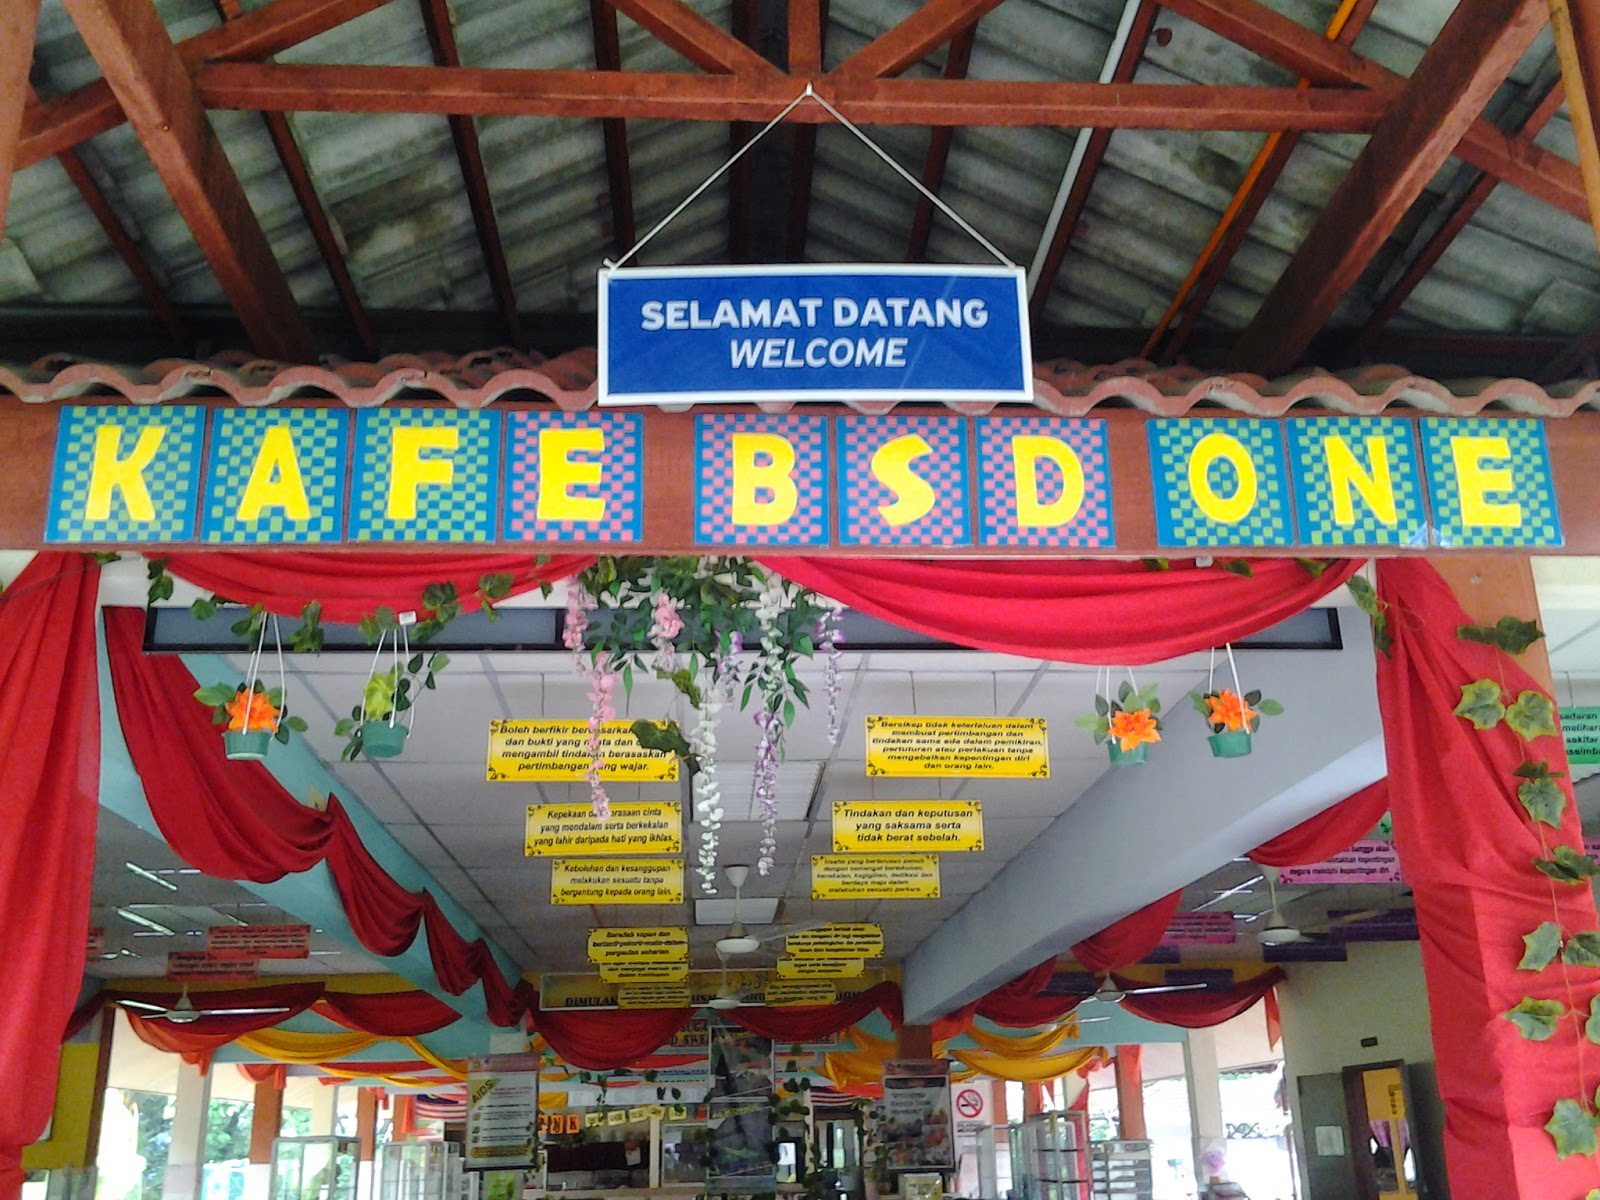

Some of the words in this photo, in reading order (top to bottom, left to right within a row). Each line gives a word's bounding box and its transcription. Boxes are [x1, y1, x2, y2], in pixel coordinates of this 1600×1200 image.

[641, 297, 823, 331] SELAMAT
[834, 297, 988, 330] DATANG
[730, 336, 909, 370] WELCOME
[85, 424, 607, 521] KAFE
[732, 432, 1085, 526] BSD
[1188, 432, 1522, 527] ONE
[500, 725, 530, 735] Boleh
[533, 725, 569, 735] berfikir
[572, 725, 634, 735] bersarka
[881, 721, 923, 730] Bersikap
[925, 721, 949, 729] tidak
[951, 721, 1003, 730] keterlaluan
[1005, 722, 1034, 730] dalam
[938, 730, 1003, 738] pertimbangan
[505, 738, 525, 747] dan
[528, 738, 553, 747] bukti
[556, 738, 581, 749] yang
[584, 739, 611, 747] nata
[615, 738, 633, 747] dan
[872, 737, 914, 745] tindakan
[502, 749, 559, 761] mengambil
[562, 749, 605, 759] tindan
[609, 749, 667, 759] berasaskan
[883, 745, 933, 754] pertuturan
[935, 745, 956, 753] atau
[958, 745, 1005, 754] perlakuan
[1008, 746, 1034, 754] tanpa
[954, 754, 1012, 762] kepentingan
[1014, 754, 1031, 762] diri
[518, 761, 589, 773] pertimbangan
[593, 763, 616, 773] ang
[924, 762, 942, 770] dan
[944, 763, 972, 771] orang
[547, 809, 587, 821] Kepekaan
[607, 808, 641, 818] erasaan
[643, 807, 662, 817] cinta
[844, 808, 892, 818] Tindakan
[895, 808, 915, 818] dan
[918, 808, 973, 819] keputusan
[541, 824, 560, 834] yang
[562, 822, 602, 832] mendalam
[604, 822, 624, 831] serta
[626, 820, 669, 830] berkekalan
[856, 822, 882, 832] yang
[885, 821, 932, 830] saksama
[935, 822, 962, 830] serta
[534, 836, 554, 847] yang
[556, 835, 574, 845] lahir
[575, 834, 609, 846] daripada
[611, 834, 627, 844] hati
[628, 834, 647, 845] yang
[858, 833, 883, 842] tidak
[887, 833, 914, 842] berat
[917, 832, 961, 842] sebelah.
[564, 864, 604, 873] Kebolehan
[605, 864, 621, 872] dan
[622, 864, 671, 875] kesanggupan
[613, 876, 641, 884] sesuatu
[643, 876, 665, 886] tanpa
[561, 888, 604, 898] bergantung
[605, 888, 632, 898] kepada
[634, 888, 656, 898] orang
[472, 1079, 496, 1104] AIDS
